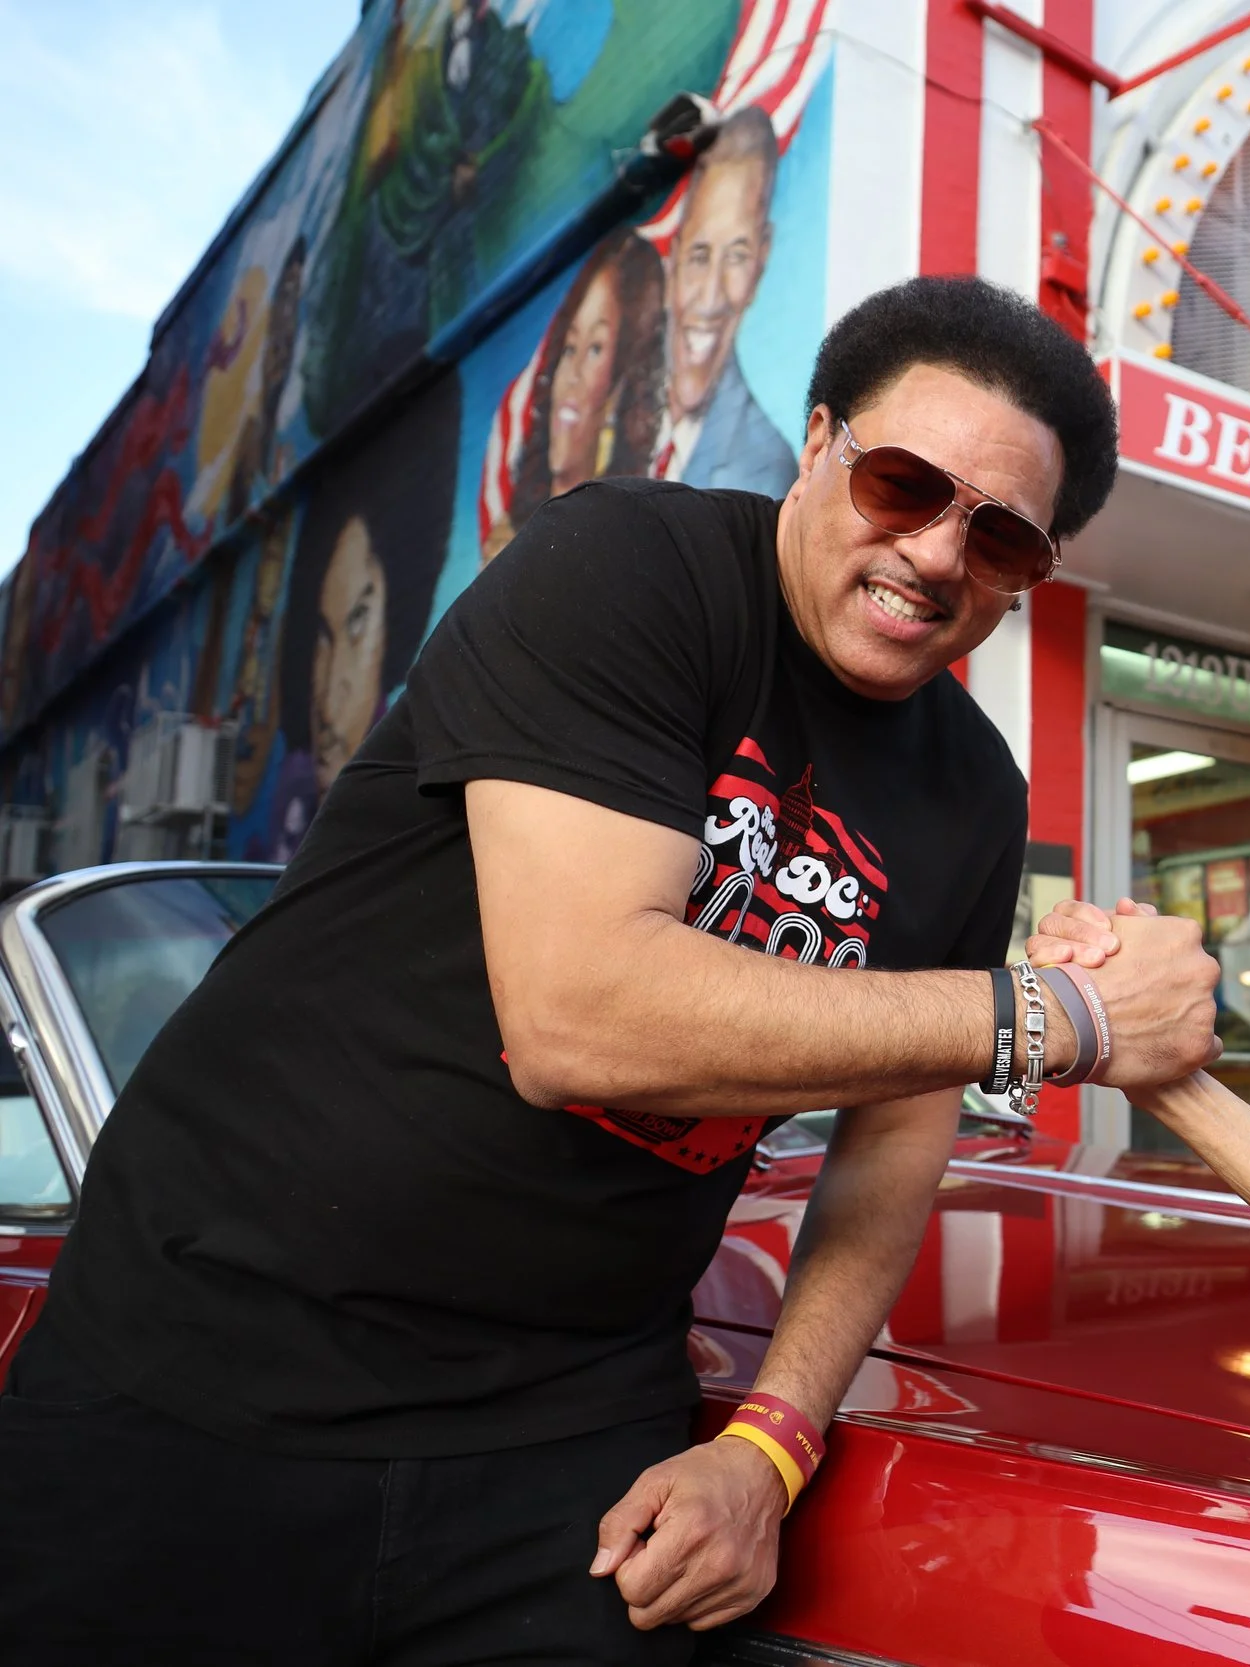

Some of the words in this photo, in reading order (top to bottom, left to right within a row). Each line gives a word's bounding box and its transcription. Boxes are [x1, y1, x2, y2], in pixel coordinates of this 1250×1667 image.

[704, 796, 778, 877] Real
[775, 855, 870, 920] DC:
[761, 805, 777, 840] The
[1083, 983, 1110, 1060] standup2cancer.org
